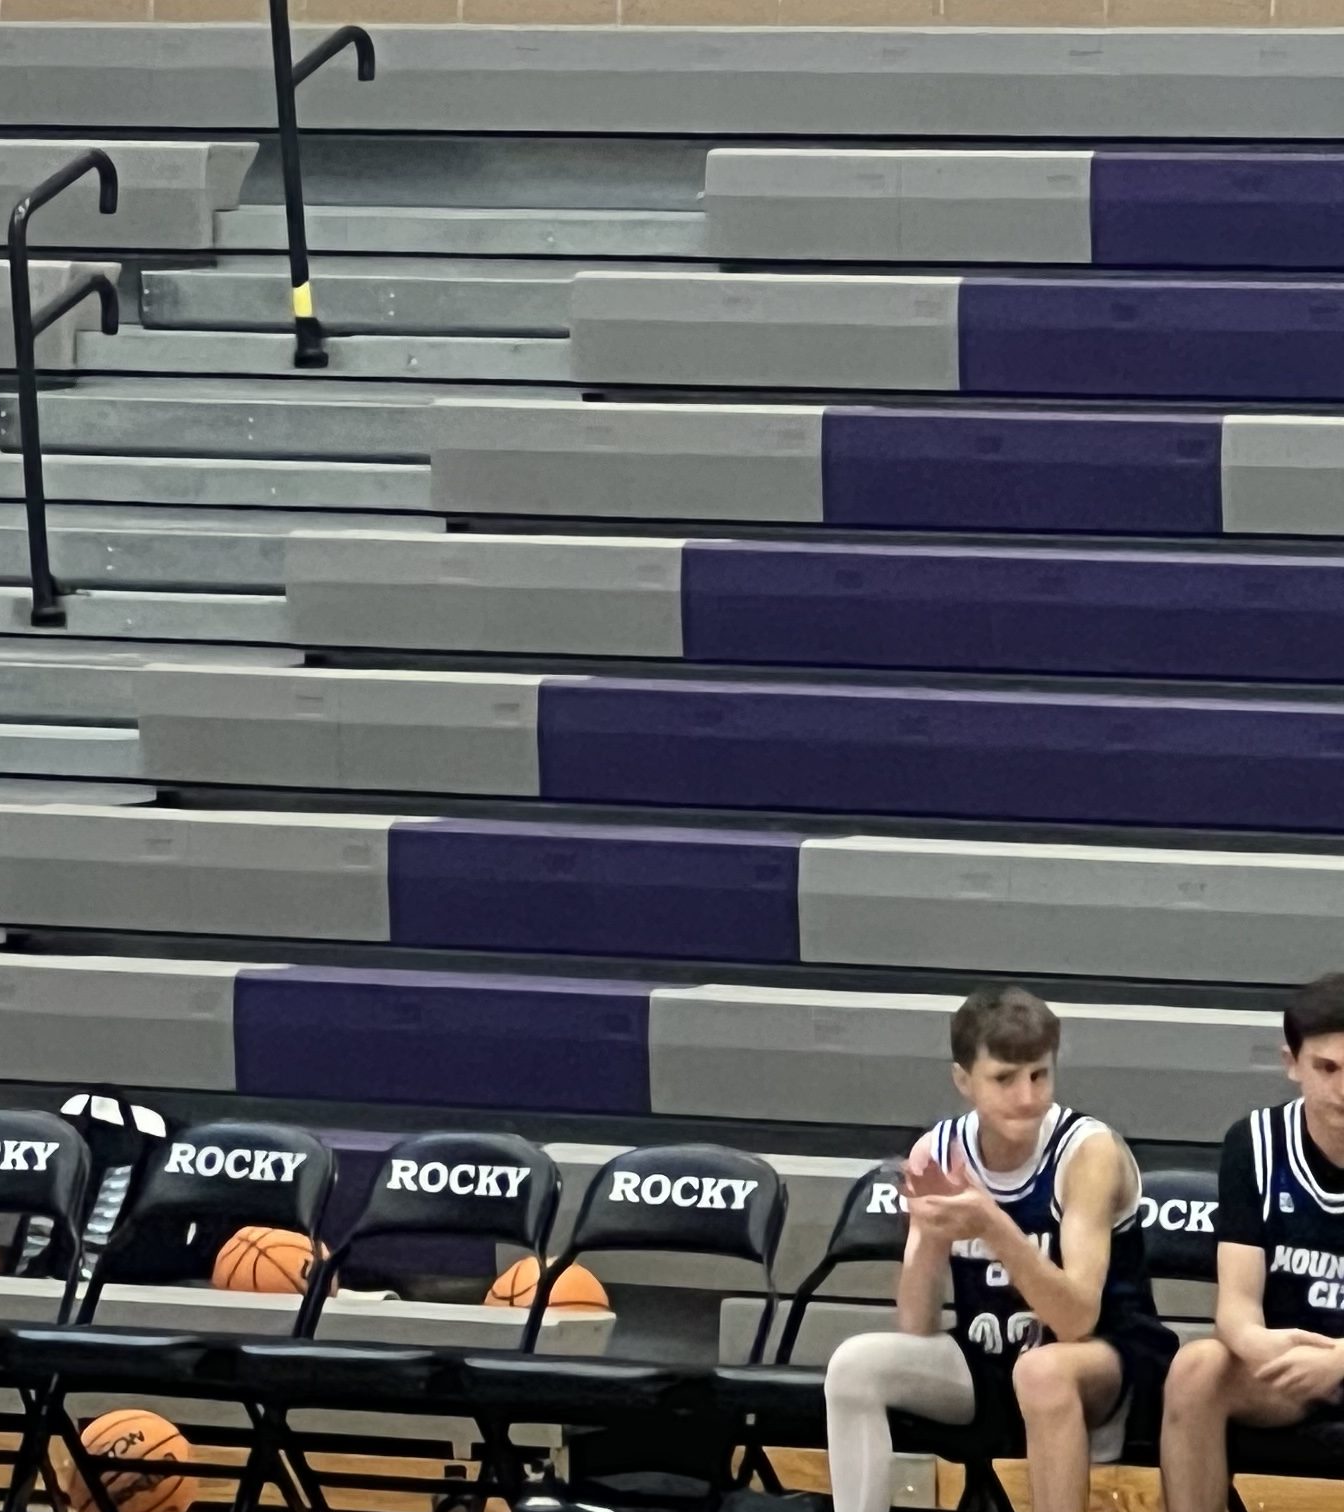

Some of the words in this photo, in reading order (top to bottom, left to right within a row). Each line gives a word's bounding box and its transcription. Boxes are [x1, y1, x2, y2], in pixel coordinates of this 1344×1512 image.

[163, 1142, 308, 1182] ROCKY
[386, 1158, 532, 1198] ROCKY
[608, 1170, 759, 1210] ROCKY
